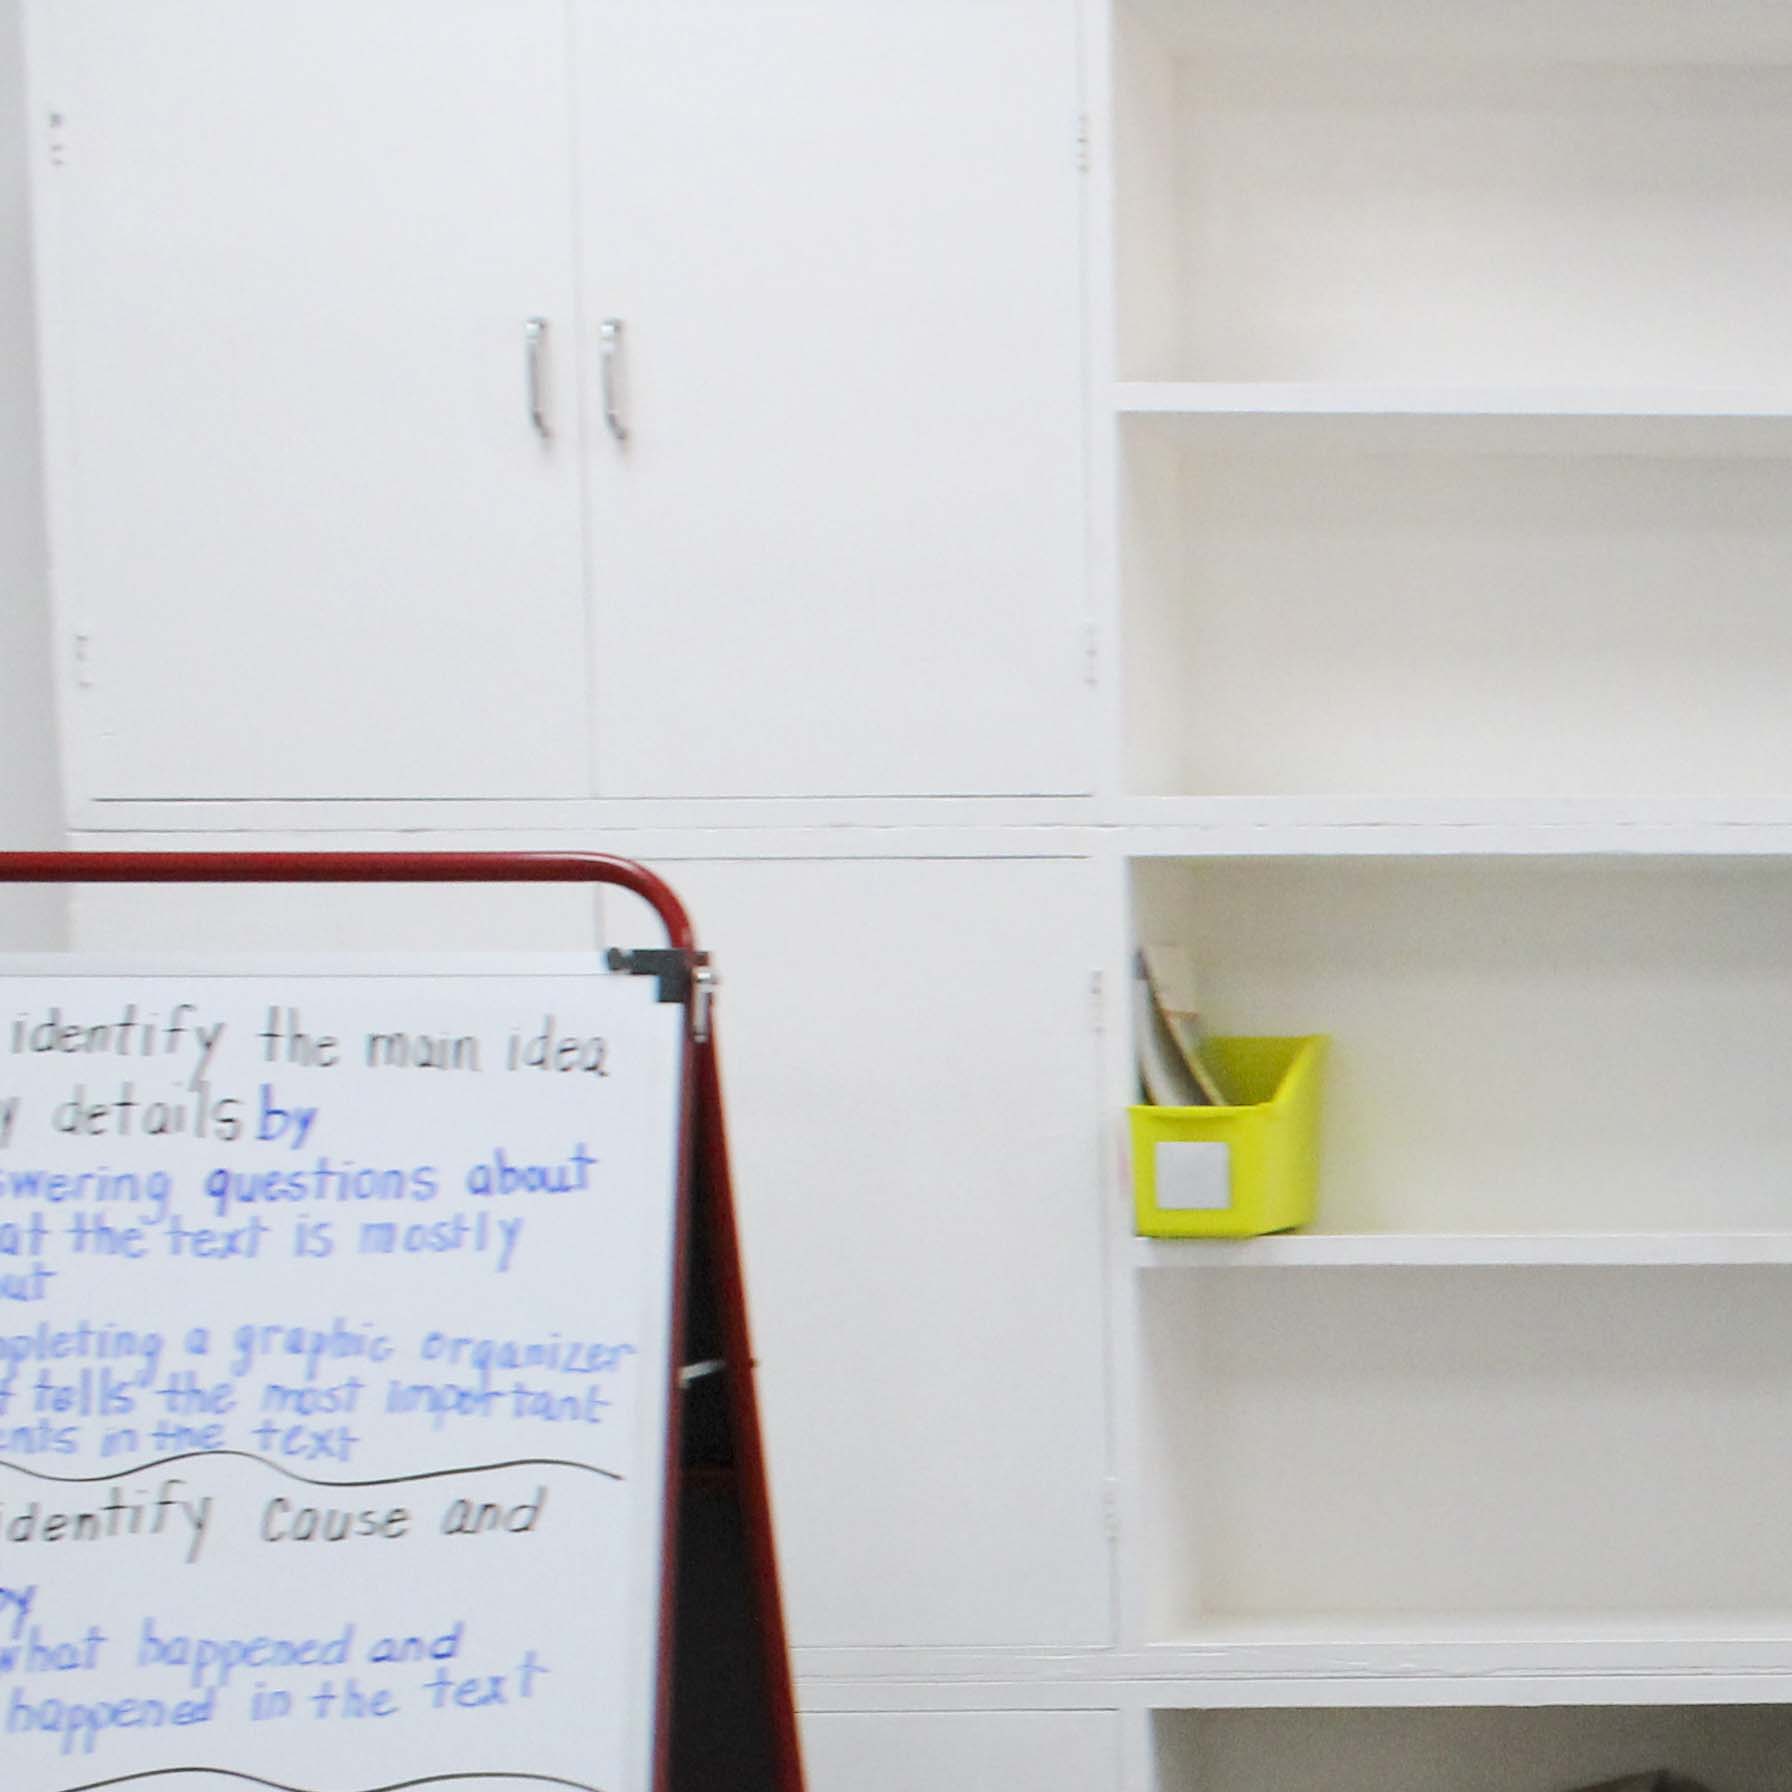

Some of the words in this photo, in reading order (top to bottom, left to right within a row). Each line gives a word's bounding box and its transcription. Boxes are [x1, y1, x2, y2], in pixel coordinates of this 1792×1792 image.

[10, 1002, 227, 1091] identify
[256, 1004, 340, 1067] the
[365, 1031, 482, 1072] main
[507, 1013, 610, 1078] idea
[50, 1080, 243, 1141] details
[255, 1083, 318, 1150] by
[204, 1155, 439, 1217] questions
[466, 1141, 599, 1195] about
[66, 1211, 148, 1258] the
[164, 1213, 271, 1259] text
[294, 1212, 335, 1258] is
[358, 1210, 525, 1273] mostly
[184, 1325, 209, 1354] a
[230, 1316, 396, 1382] graphic
[419, 1331, 640, 1390] organizer
[33, 1366, 137, 1416] tells
[154, 1370, 237, 1414] the
[262, 1376, 366, 1417] most
[386, 1379, 614, 1432] important
[100, 1426, 140, 1457] in
[149, 1420, 225, 1451] the
[251, 1419, 360, 1461] text
[440, 1486, 548, 1536] and
[136, 1616, 357, 1689] happened
[368, 1620, 466, 1664] and
[3, 1685, 220, 1754] happened
[249, 1680, 293, 1721] in
[307, 1675, 402, 1721] the
[421, 1648, 552, 1708] text
